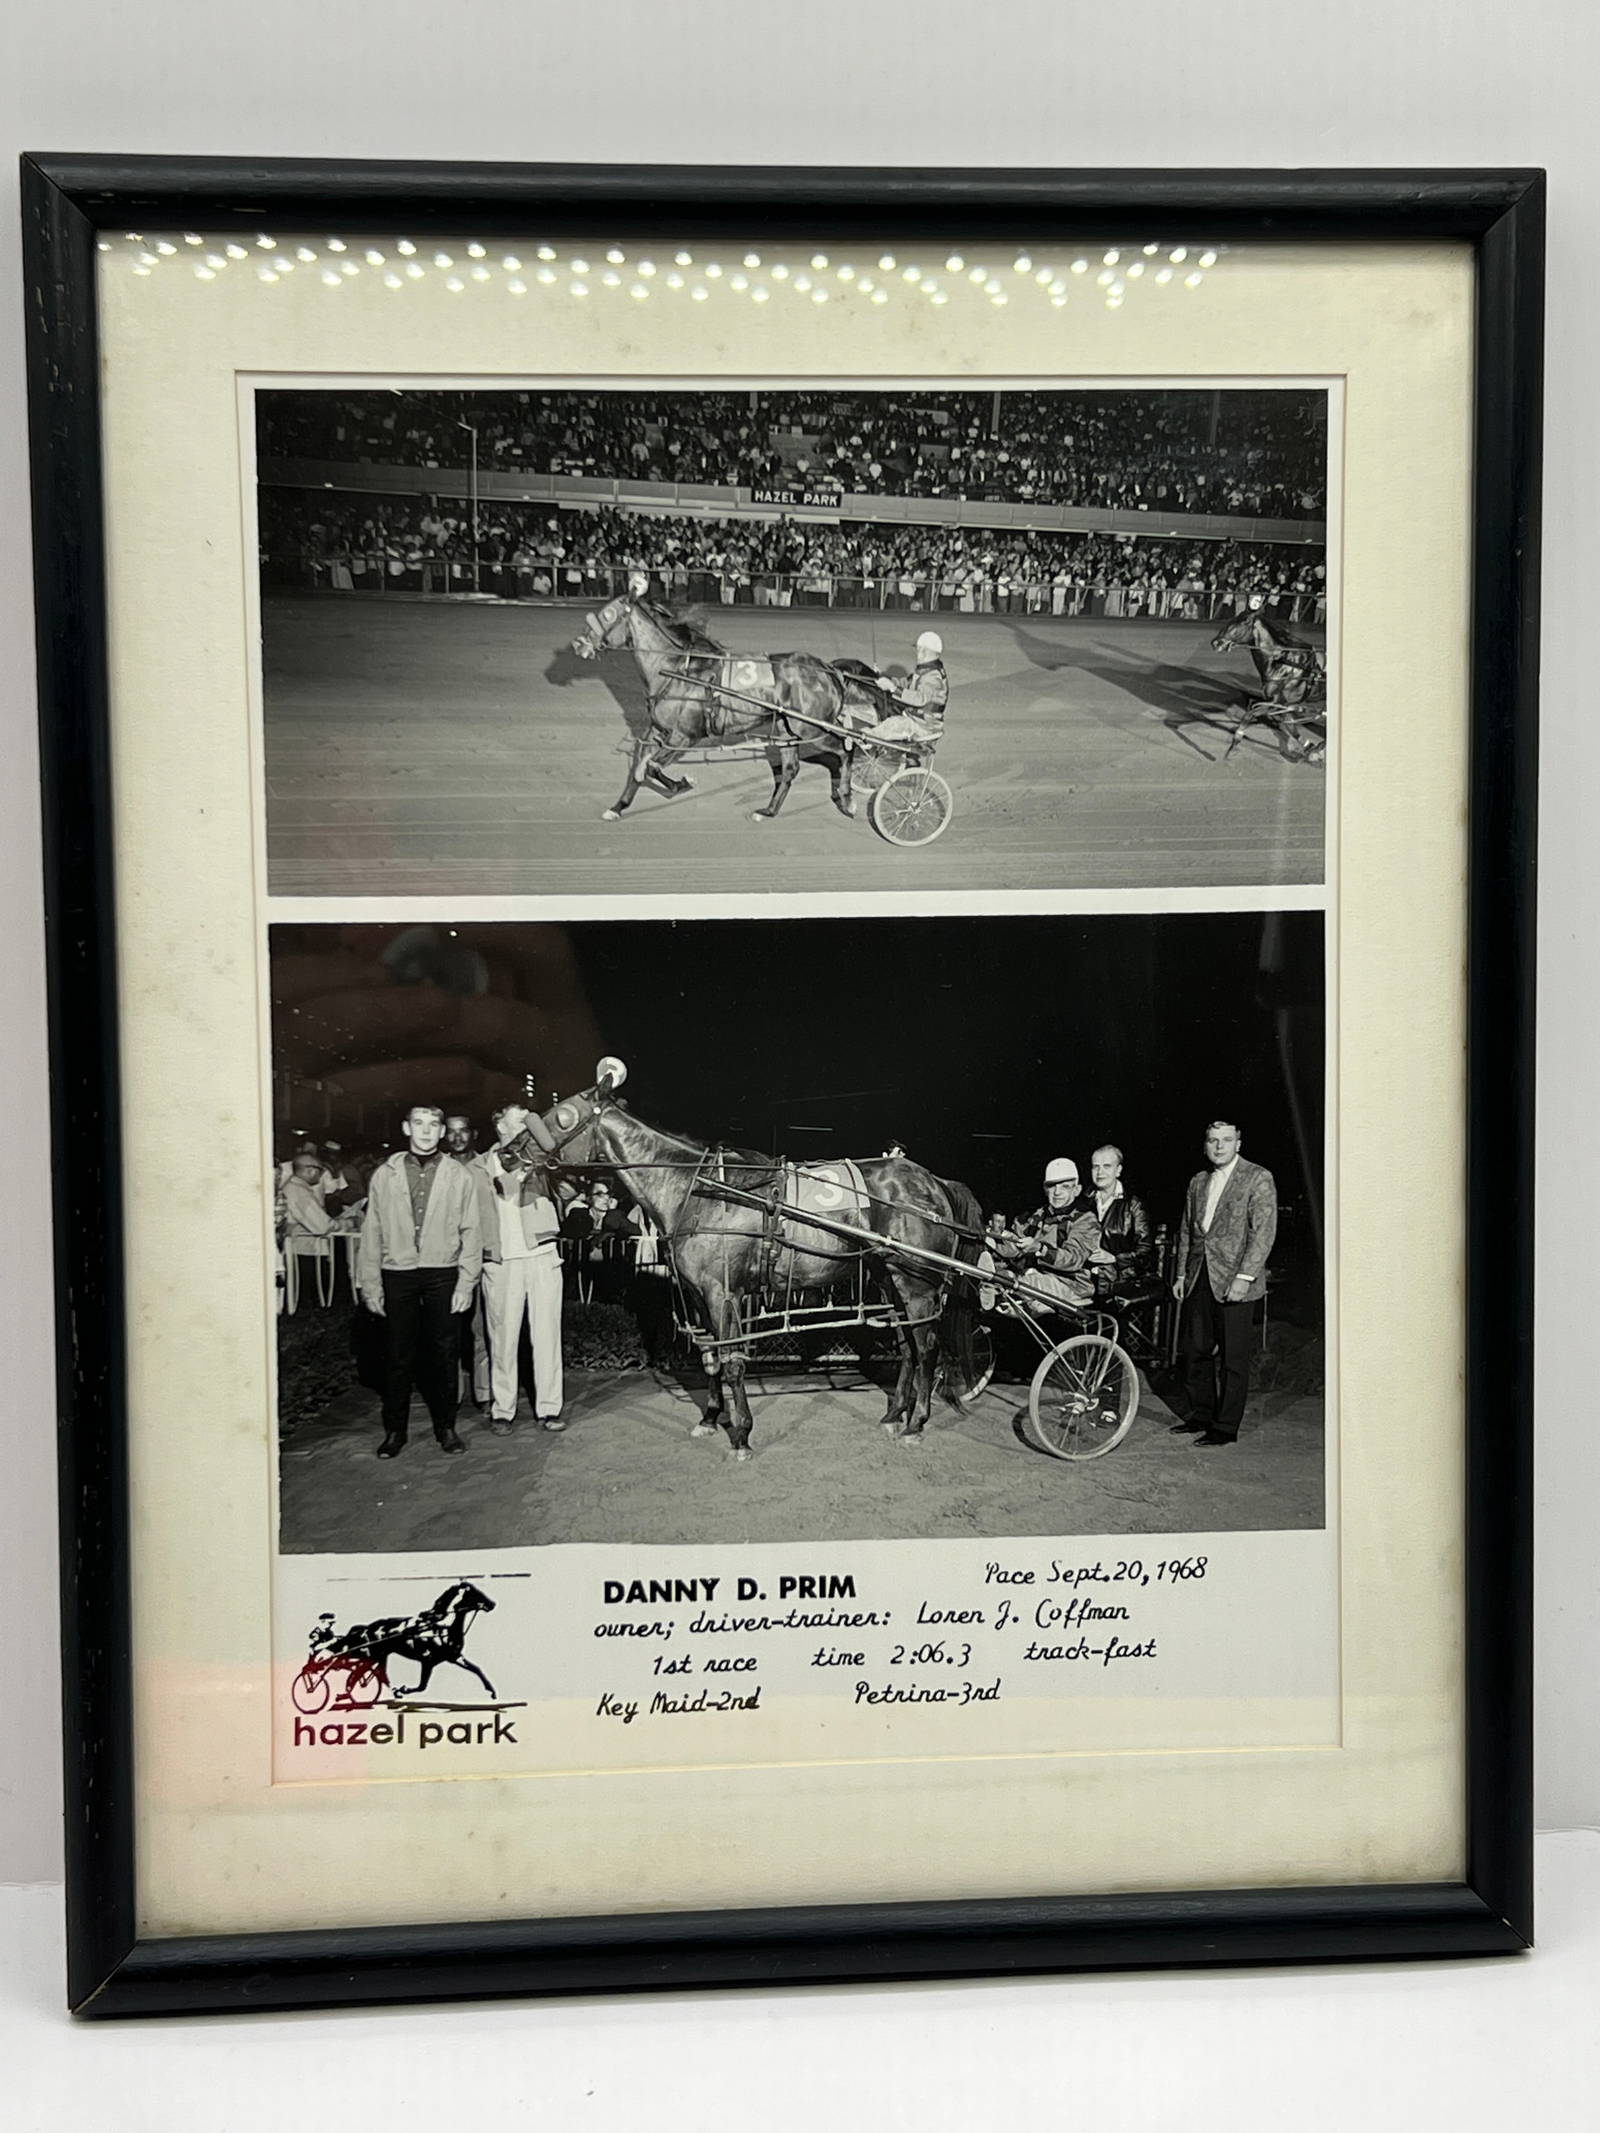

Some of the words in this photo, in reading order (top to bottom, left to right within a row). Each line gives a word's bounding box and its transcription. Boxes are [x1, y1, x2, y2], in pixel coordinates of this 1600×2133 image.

[755, 490, 797, 504] HAZEL
[803, 493, 838, 507] PARK
[737, 660, 757, 686] 3
[814, 1168, 844, 1208] 3
[603, 1577, 721, 1604] DANNY
[737, 1577, 767, 1601] D.
[779, 1575, 857, 1600] PRIM
[985, 1561, 1036, 1585] Pace
[593, 1620, 675, 1641] owner;
[689, 1607, 891, 1635] driver-trainer:
[916, 1600, 986, 1625] Loren
[994, 1599, 1020, 1631] J.
[1035, 1598, 1130, 1629] Coffman
[653, 1654, 693, 1676] 1st
[703, 1656, 758, 1673] race
[810, 1647, 865, 1667] time
[890, 1640, 972, 1668] 2:06.3
[1023, 1636, 1157, 1667] track-fast
[596, 1692, 640, 1725] Key
[649, 1685, 762, 1715] Maid-2nd
[854, 1677, 1001, 1706] Petrina-3rd
[294, 1714, 405, 1747] hazel
[419, 1713, 518, 1750] park
